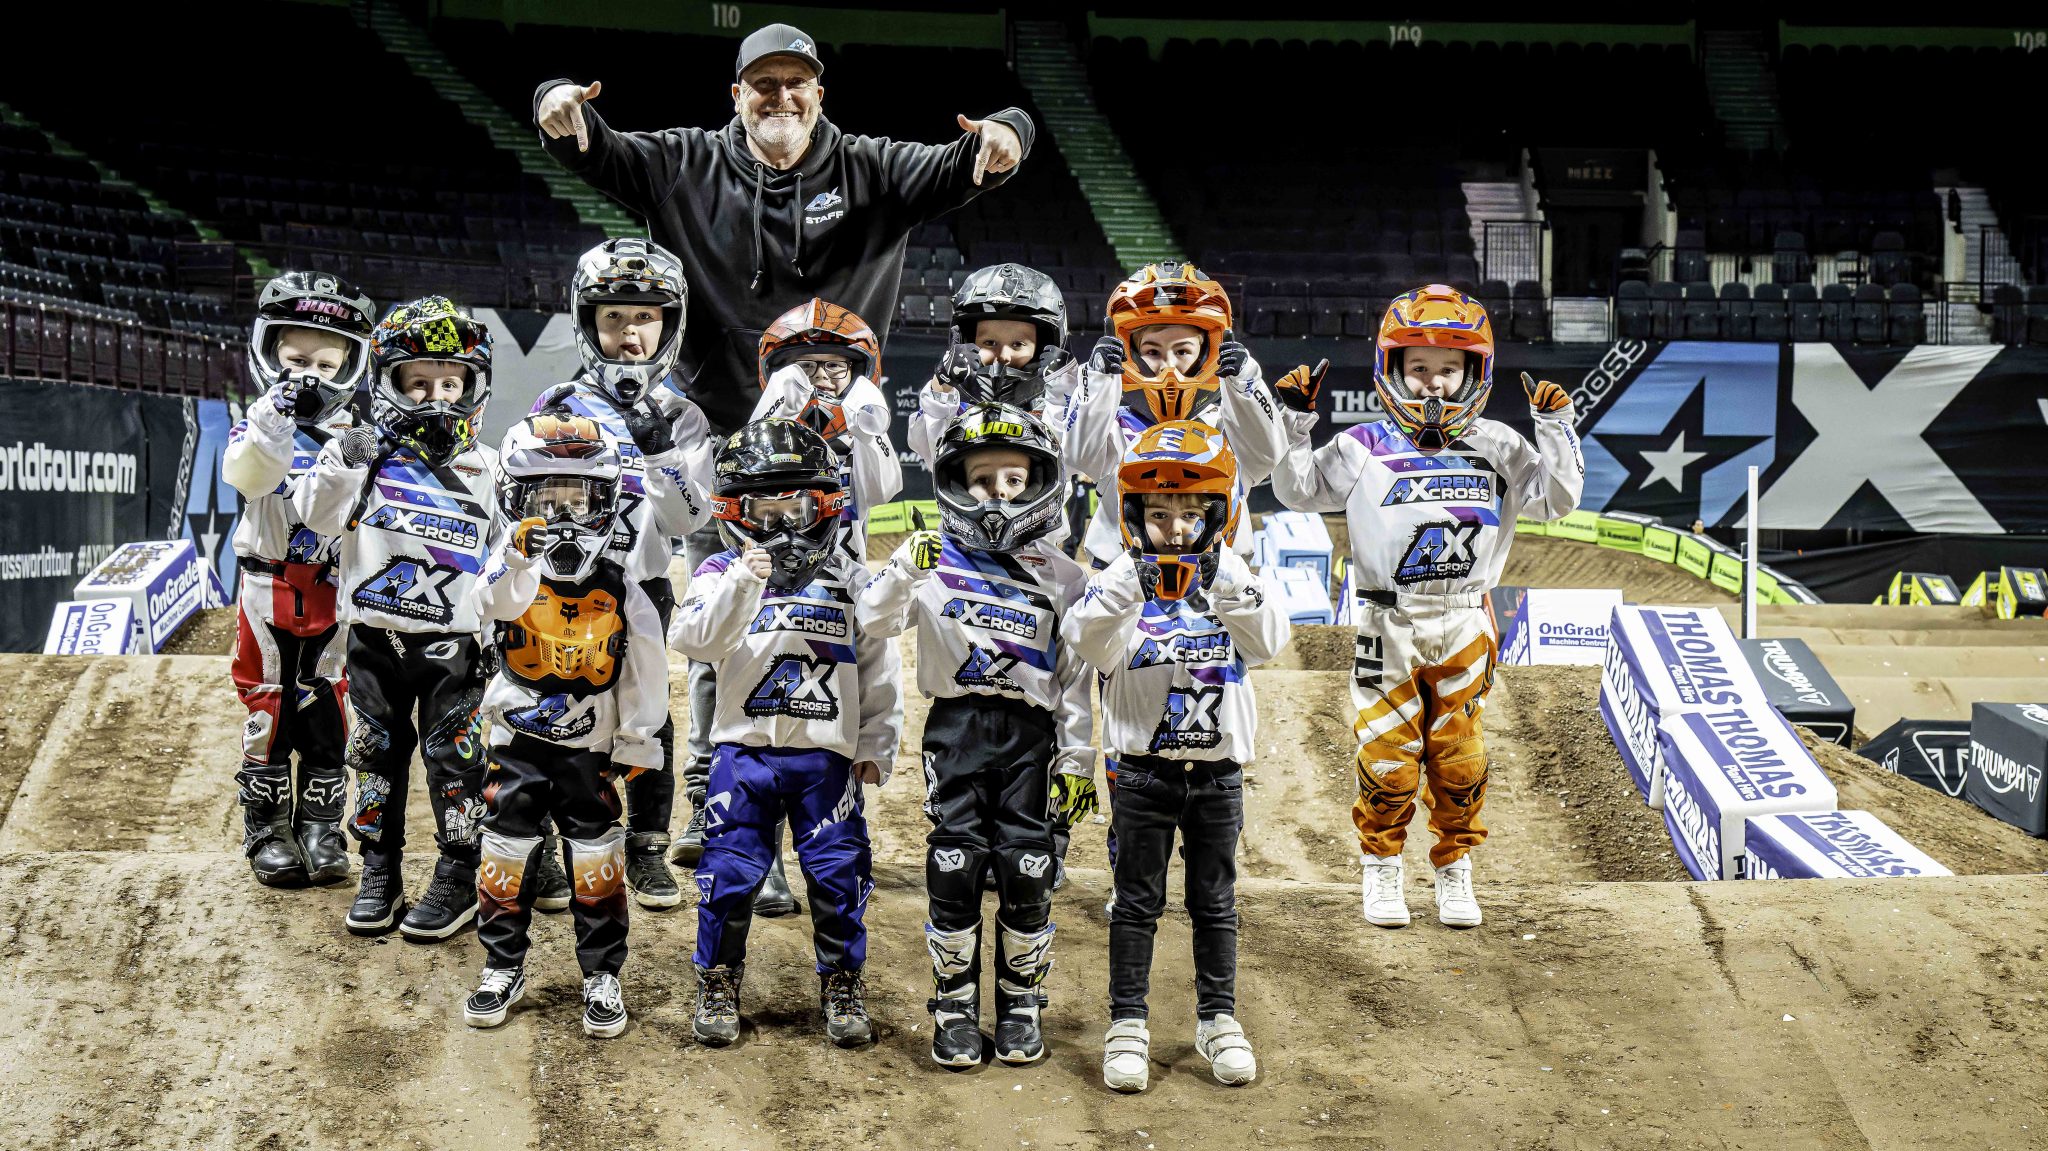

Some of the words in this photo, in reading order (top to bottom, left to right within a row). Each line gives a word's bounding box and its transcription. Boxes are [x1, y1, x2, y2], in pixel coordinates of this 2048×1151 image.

[712, 3, 741, 28] 110
[1389, 25, 1422, 48] 109
[805, 210, 844, 224] STAFF
[312, 314, 331, 324] FOX
[1402, 458, 1477, 468] RACE
[1381, 476, 1431, 505] AX
[1427, 476, 1488, 488] ARENA
[1429, 488, 1490, 501] CROSS
[395, 490, 469, 510] RACE
[361, 504, 418, 534] AX
[411, 511, 478, 537] ARENA
[412, 525, 477, 548] CROSS
[1404, 527, 1475, 568] AX
[0, 545, 73, 580] ossworldtour
[150, 560, 200, 621] OnGrade
[363, 561, 454, 608] AX
[958, 579, 1035, 602] RACE
[356, 590, 445, 616] ARENACROSS
[788, 604, 846, 624] ARENA
[942, 598, 982, 626] AX
[977, 604, 1036, 627] ARENA
[750, 604, 793, 634] AX
[792, 617, 847, 636] CROSS
[979, 616, 1036, 639] CROSS
[1149, 618, 1221, 633] RACE
[1130, 637, 1177, 669] AX
[1549, 638, 1579, 646] Machine
[1580, 639, 1607, 647] Control
[1661, 612, 1743, 707] THOMAS
[1760, 640, 1816, 696] TRIUMPH
[755, 659, 832, 702] AX
[1669, 664, 1689, 687] Plant
[1605, 636, 1657, 759] THOMAS
[1678, 683, 1696, 703] Hire
[1705, 708, 1807, 798] THOMAS
[1970, 740, 2026, 792] TRIUMPH
[1722, 764, 1744, 785] Plant
[1739, 779, 1759, 800] Hire
[1802, 812, 1922, 877] THOMAS
[482, 852, 514, 892] OX
[582, 852, 626, 890] FOX
